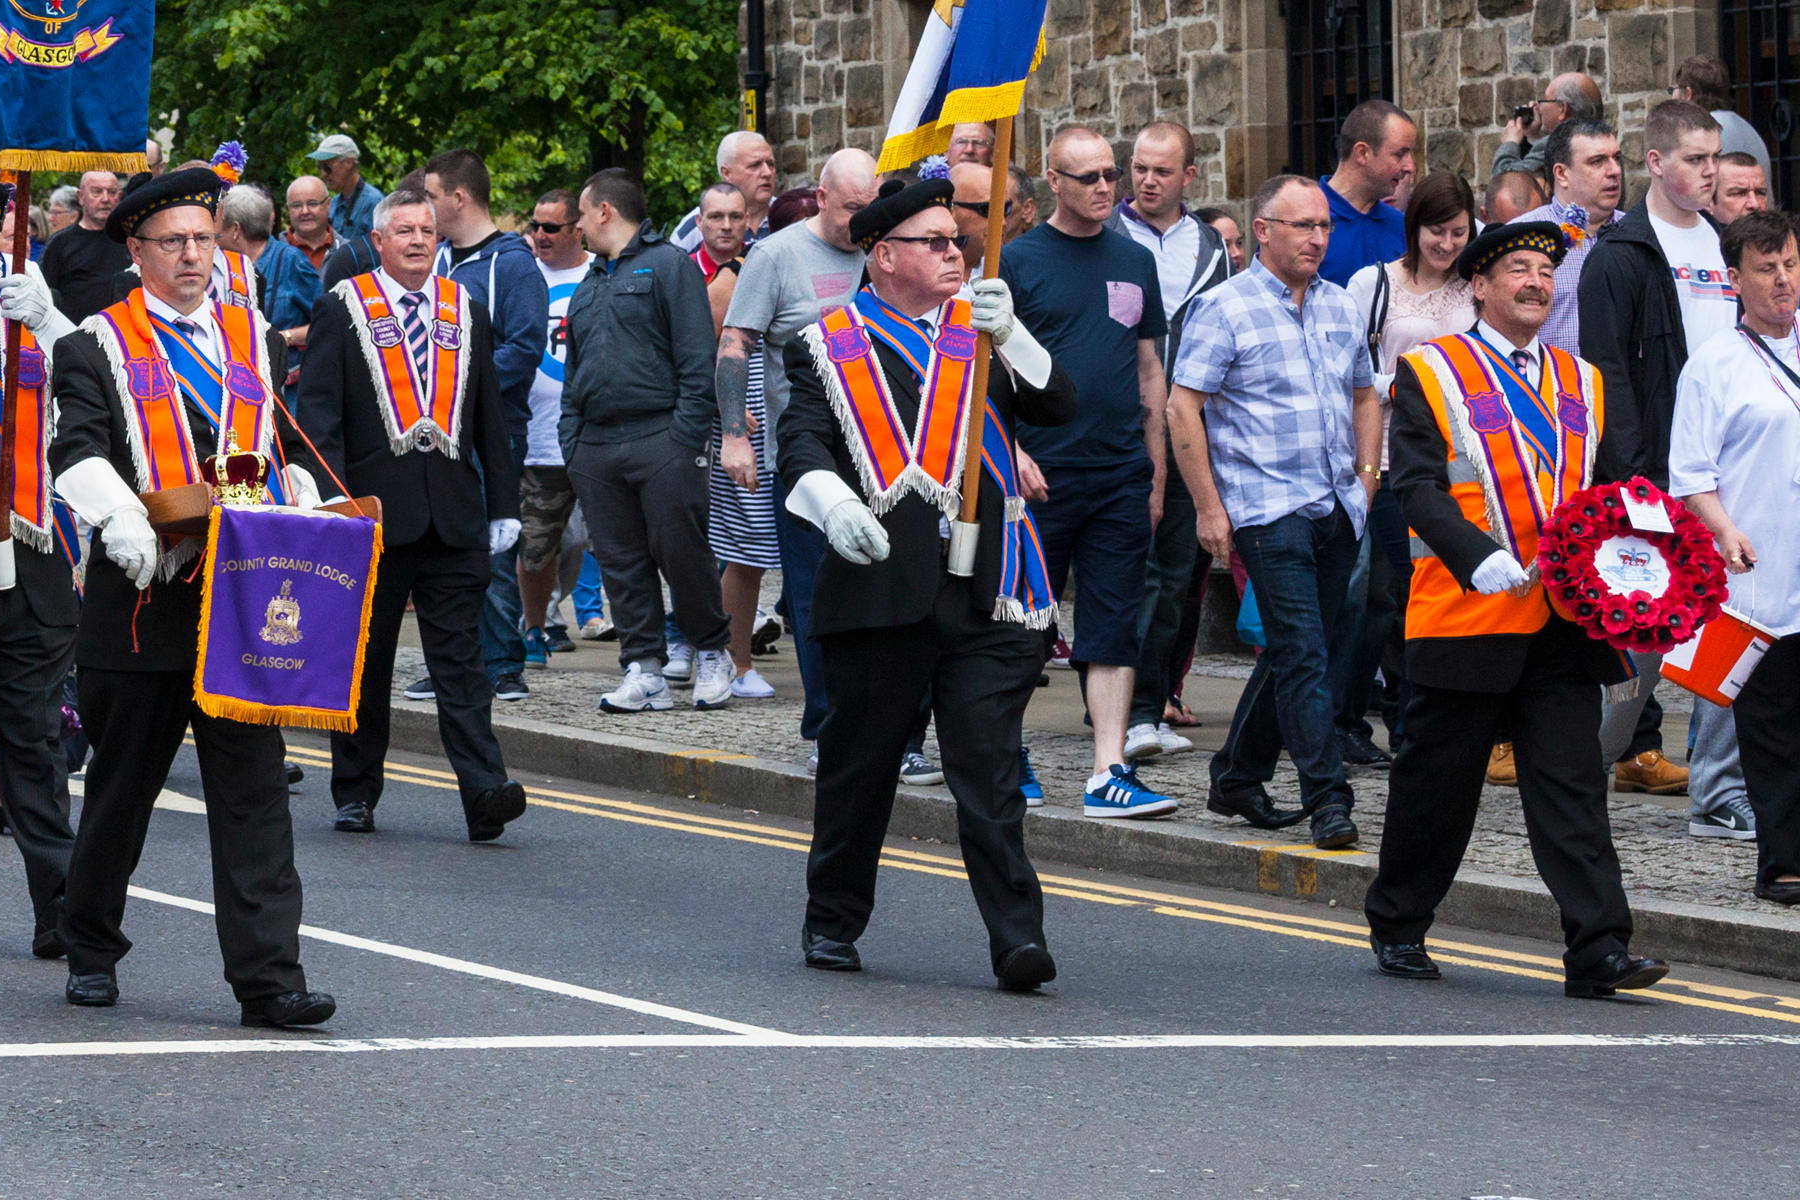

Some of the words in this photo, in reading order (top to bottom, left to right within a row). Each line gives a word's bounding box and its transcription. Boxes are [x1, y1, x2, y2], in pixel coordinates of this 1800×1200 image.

[44, 21, 62, 35] OF
[17, 39, 76, 63] GLASGO
[219, 557, 265, 574] COUNTY
[268, 556, 313, 573] GRAND
[314, 563, 357, 591] LODGE
[241, 653, 305, 670] GLASGOW
